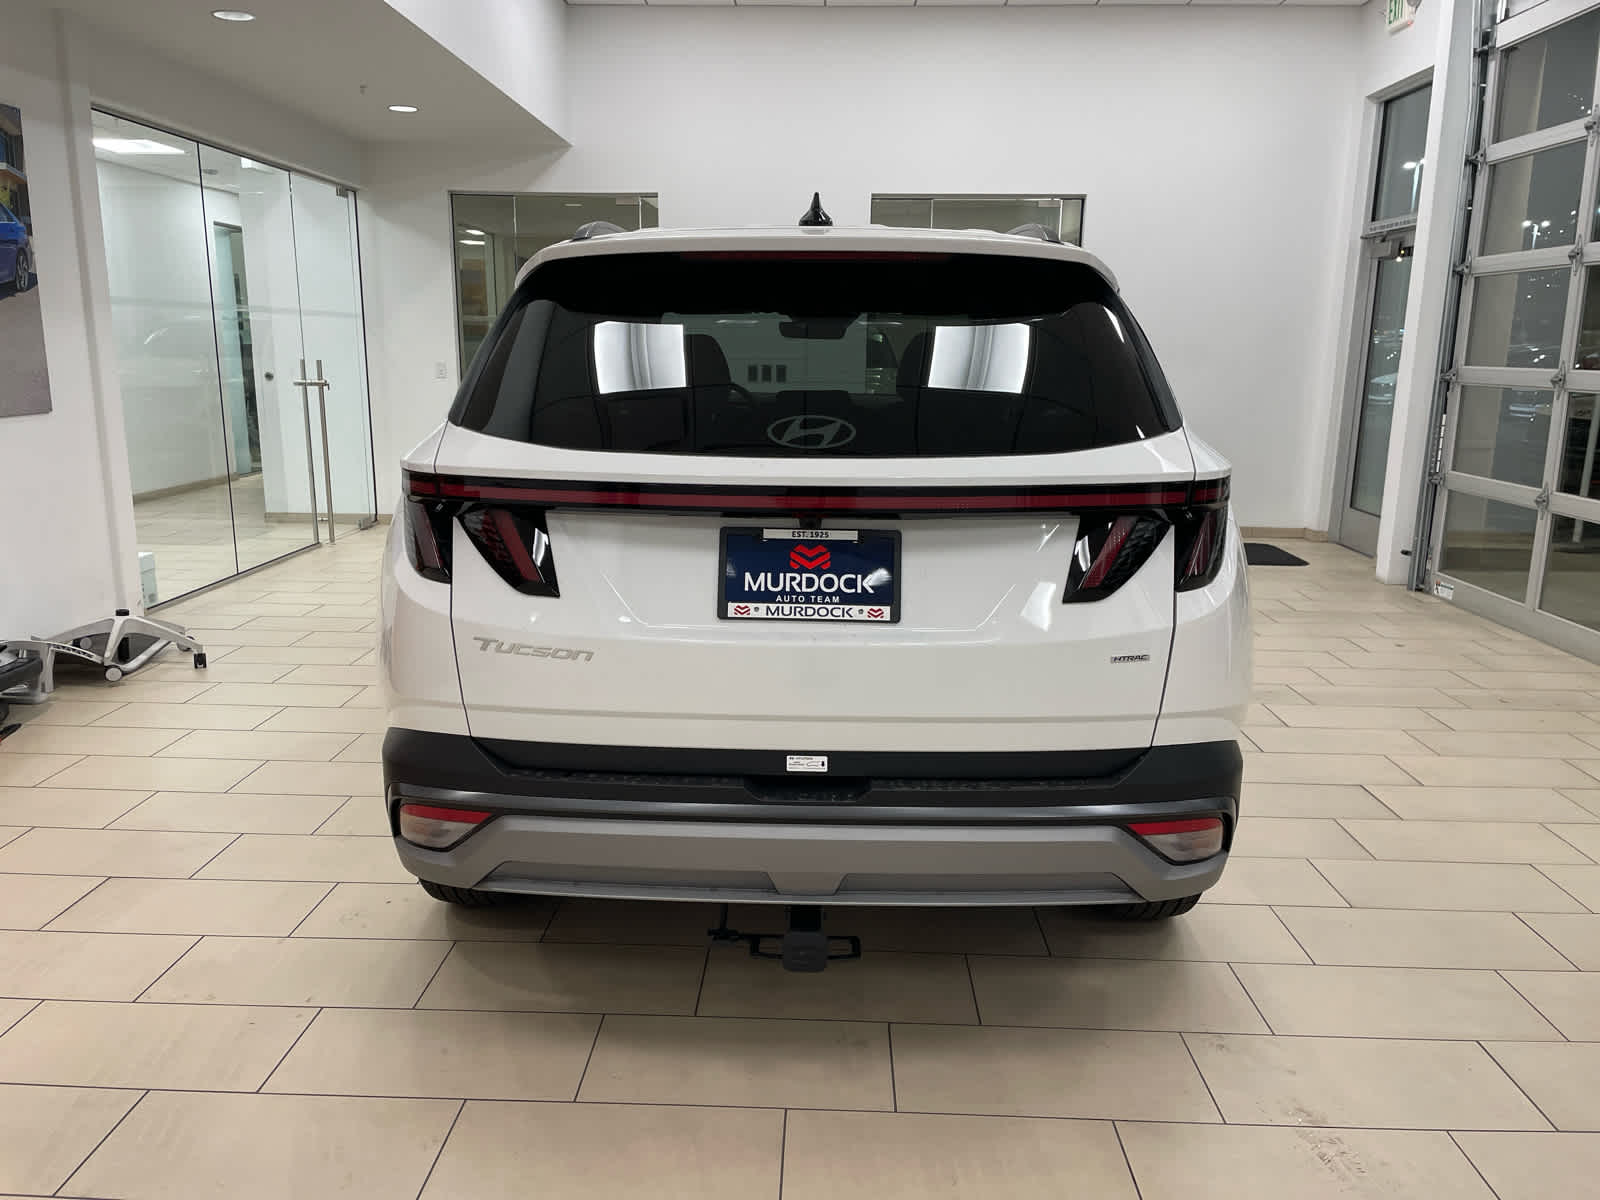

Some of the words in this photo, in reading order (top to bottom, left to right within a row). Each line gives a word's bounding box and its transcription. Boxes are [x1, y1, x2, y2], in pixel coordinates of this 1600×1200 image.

[791, 531, 809, 539] EST.
[810, 531, 830, 539] 1925
[744, 572, 875, 594] MURDOCK
[775, 594, 805, 603] AUTO
[810, 595, 840, 604] TEAM
[765, 605, 854, 618] MURDOCK
